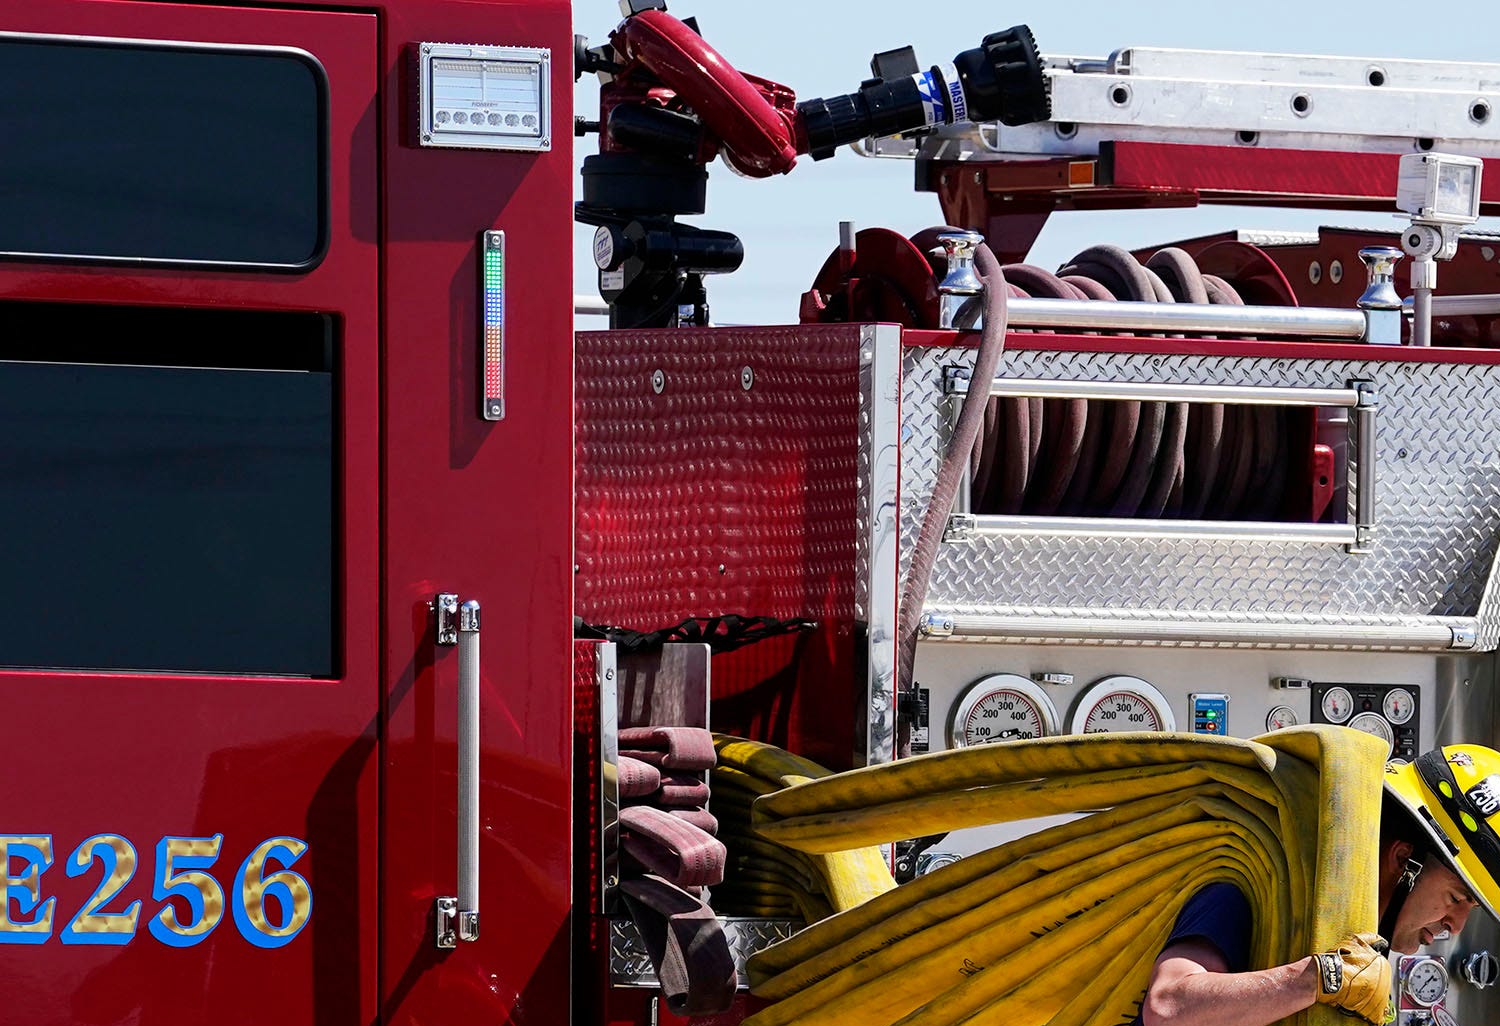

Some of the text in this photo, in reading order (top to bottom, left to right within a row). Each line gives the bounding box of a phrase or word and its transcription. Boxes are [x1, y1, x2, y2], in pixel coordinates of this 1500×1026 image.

[998, 702, 1014, 711] 300
[1116, 703, 1132, 712] 300
[982, 709, 999, 718] 200
[1010, 711, 1027, 720] 400
[1101, 711, 1117, 720] 200
[1128, 714, 1144, 722] 400
[975, 727, 991, 736] 100
[1016, 731, 1033, 740] 500
[0, 833, 313, 949] E256
